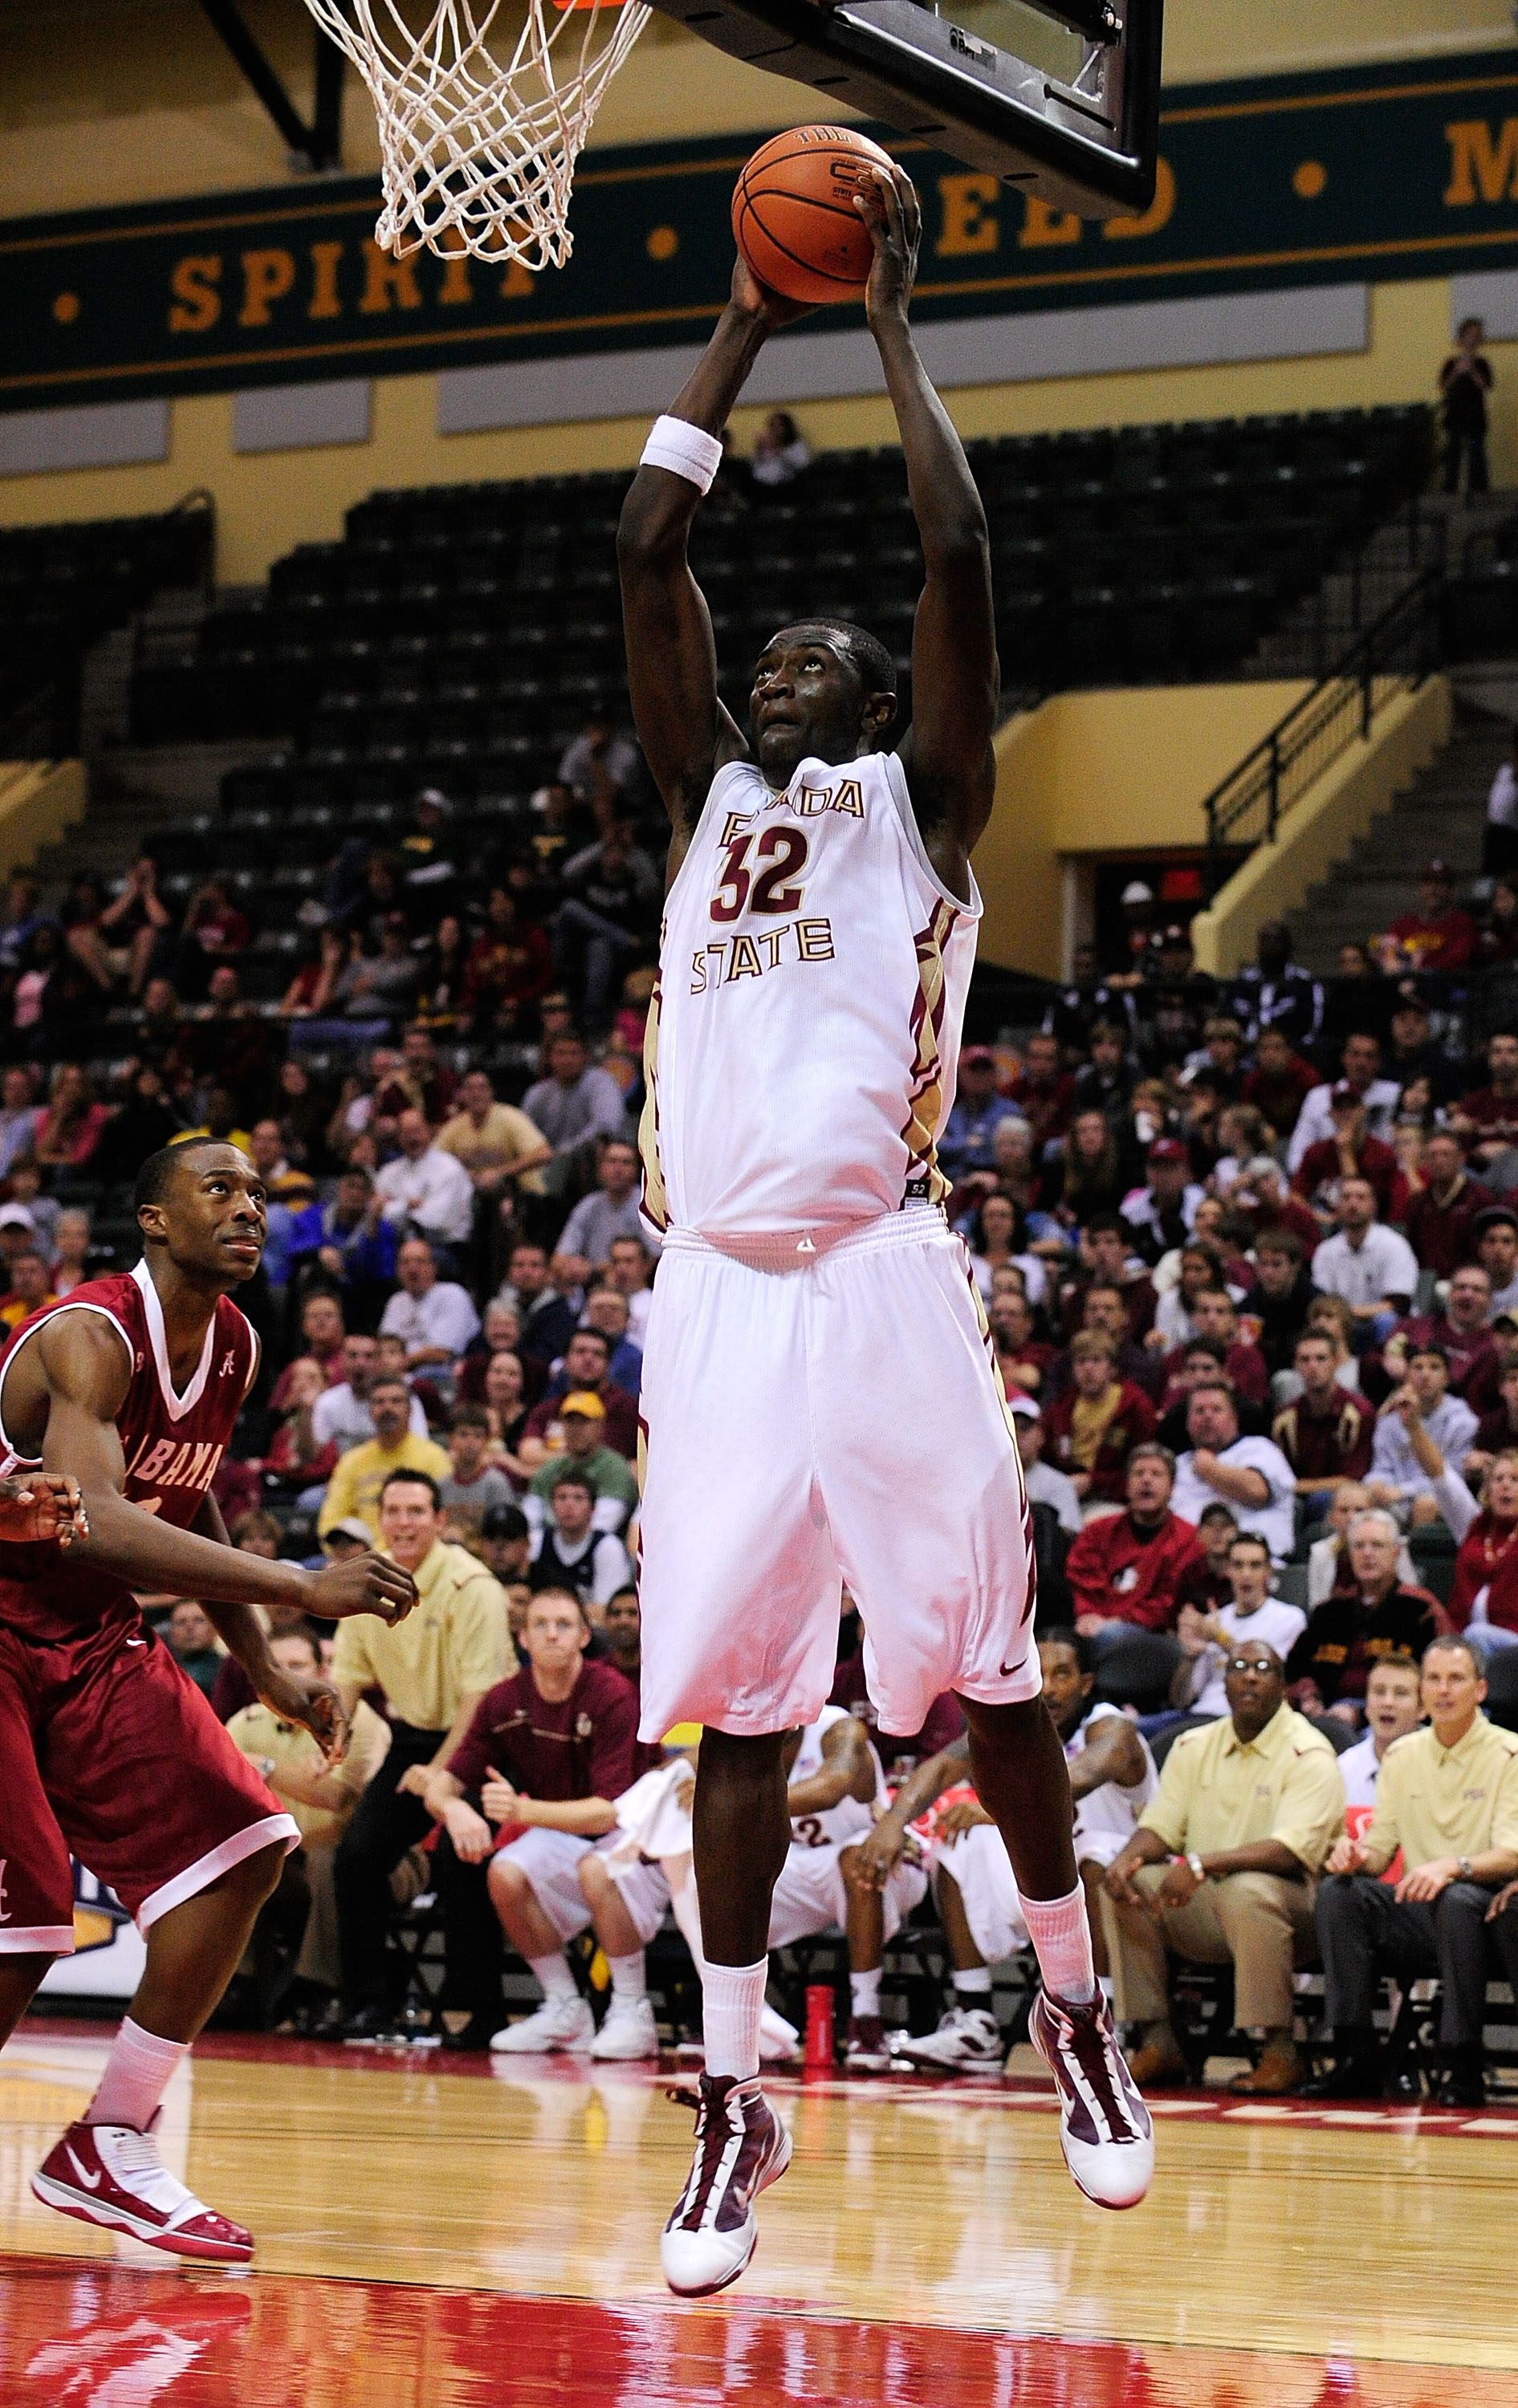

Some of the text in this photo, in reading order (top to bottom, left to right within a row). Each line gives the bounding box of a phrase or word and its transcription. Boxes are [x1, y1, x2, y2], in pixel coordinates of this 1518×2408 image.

[794, 127, 852, 144] THE
[169, 215, 544, 333] SPIRIT
[710, 822, 809, 925] 32
[690, 917, 836, 995] STATE
[911, 1184, 926, 1194] 52
